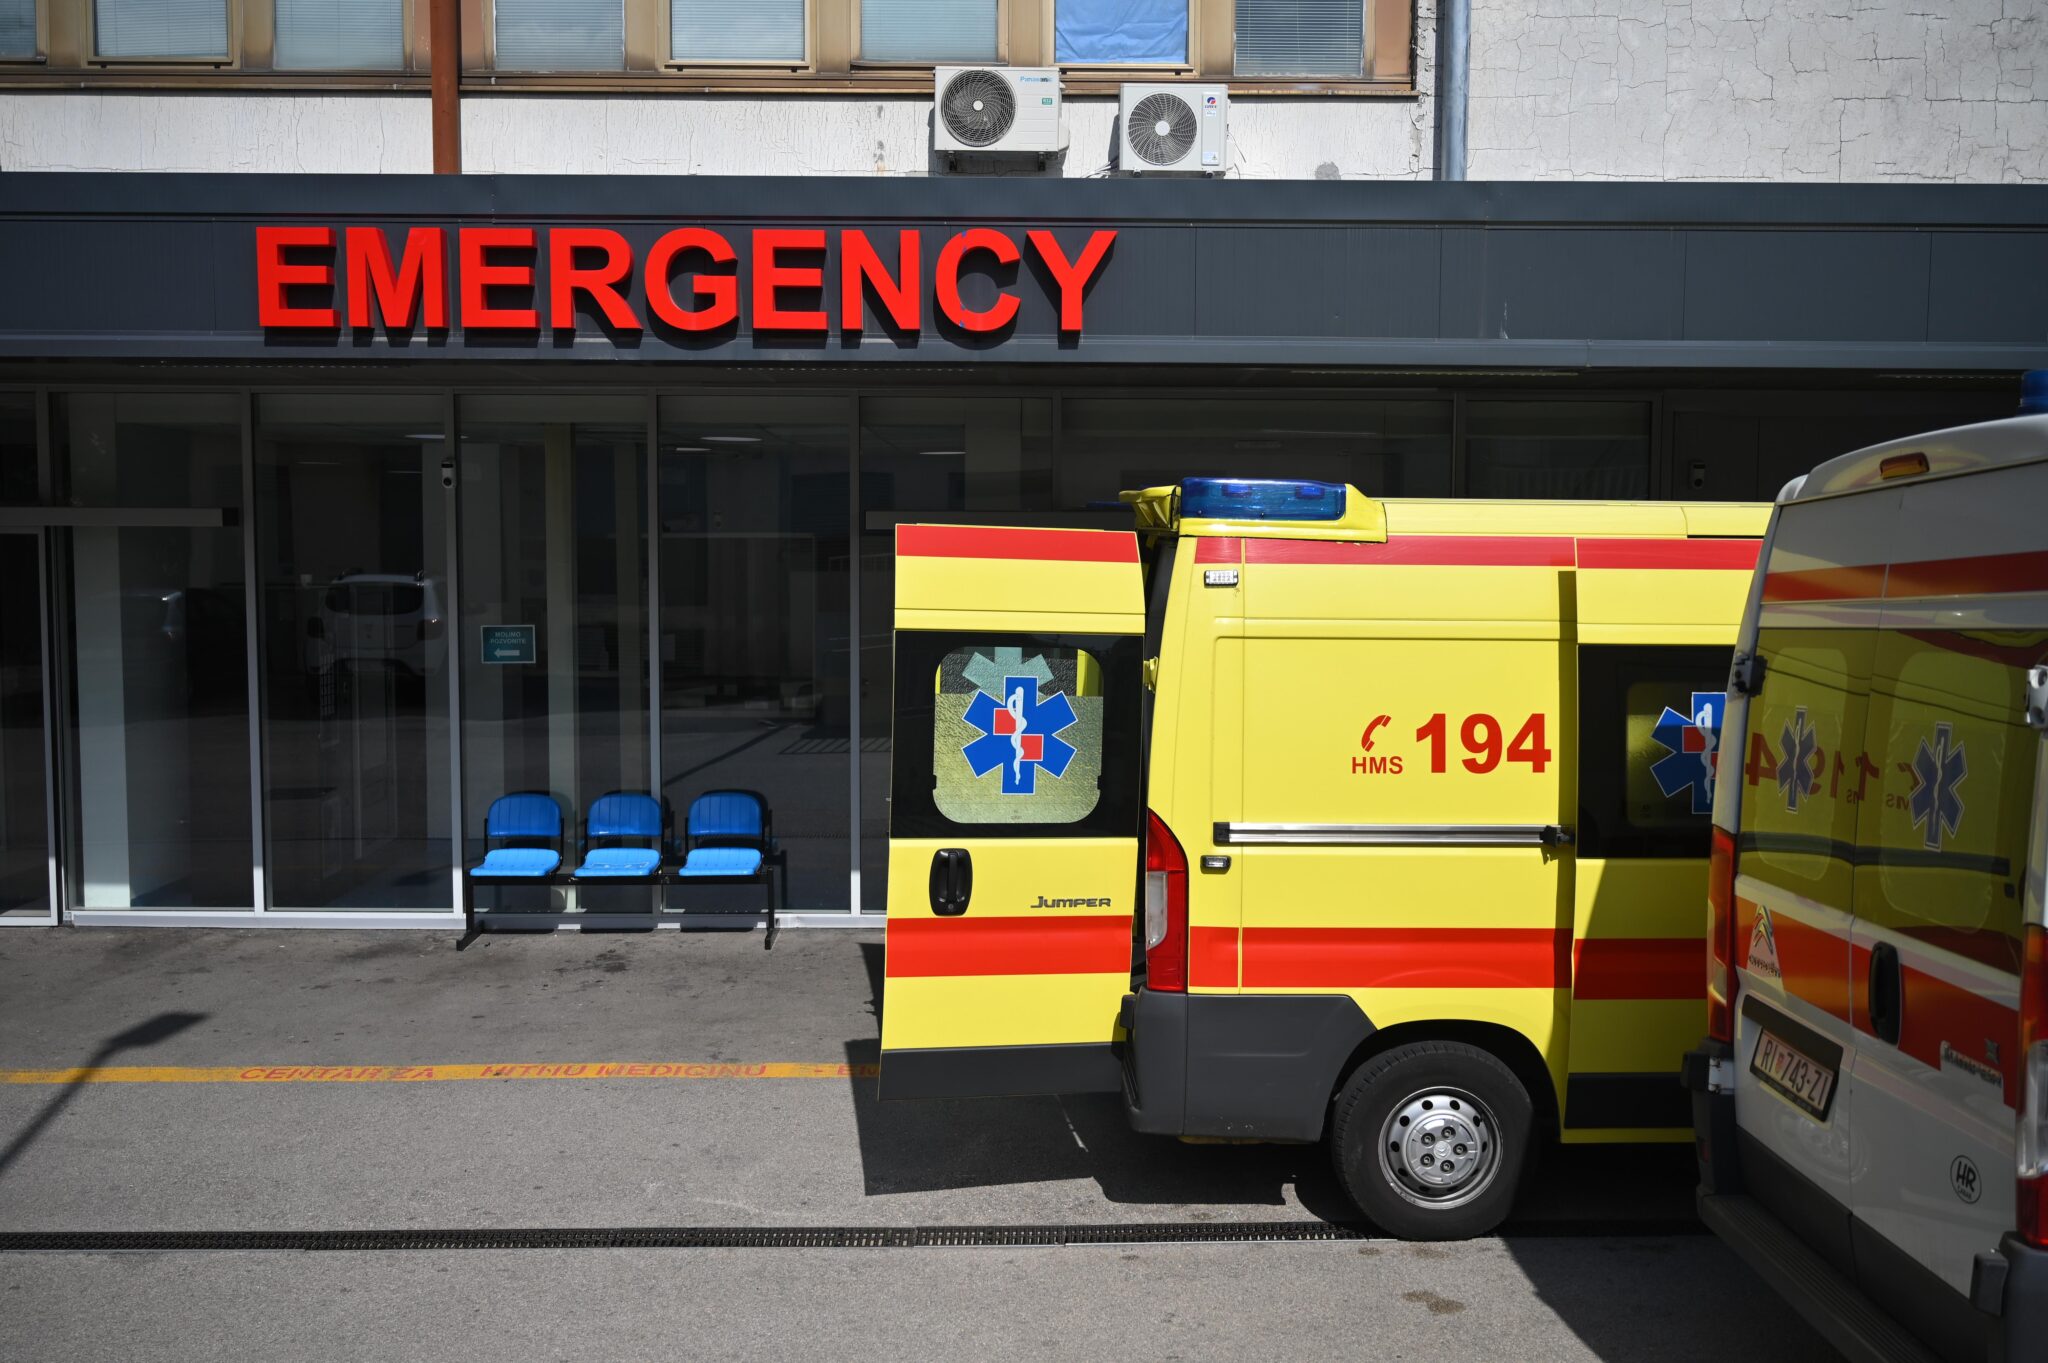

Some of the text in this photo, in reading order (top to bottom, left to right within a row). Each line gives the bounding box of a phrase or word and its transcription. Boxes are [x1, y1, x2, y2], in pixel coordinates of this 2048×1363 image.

[256, 227, 1117, 331] EMERGENCY
[1416, 713, 1552, 774] 194
[1351, 757, 1404, 775] HMS
[239, 1068, 384, 1080] CENTAR
[390, 1067, 434, 1079] ZA
[596, 1065, 767, 1077] MEDICINU
[1760, 1039, 1779, 1073] RI
[1955, 1160, 1977, 1193] HR
